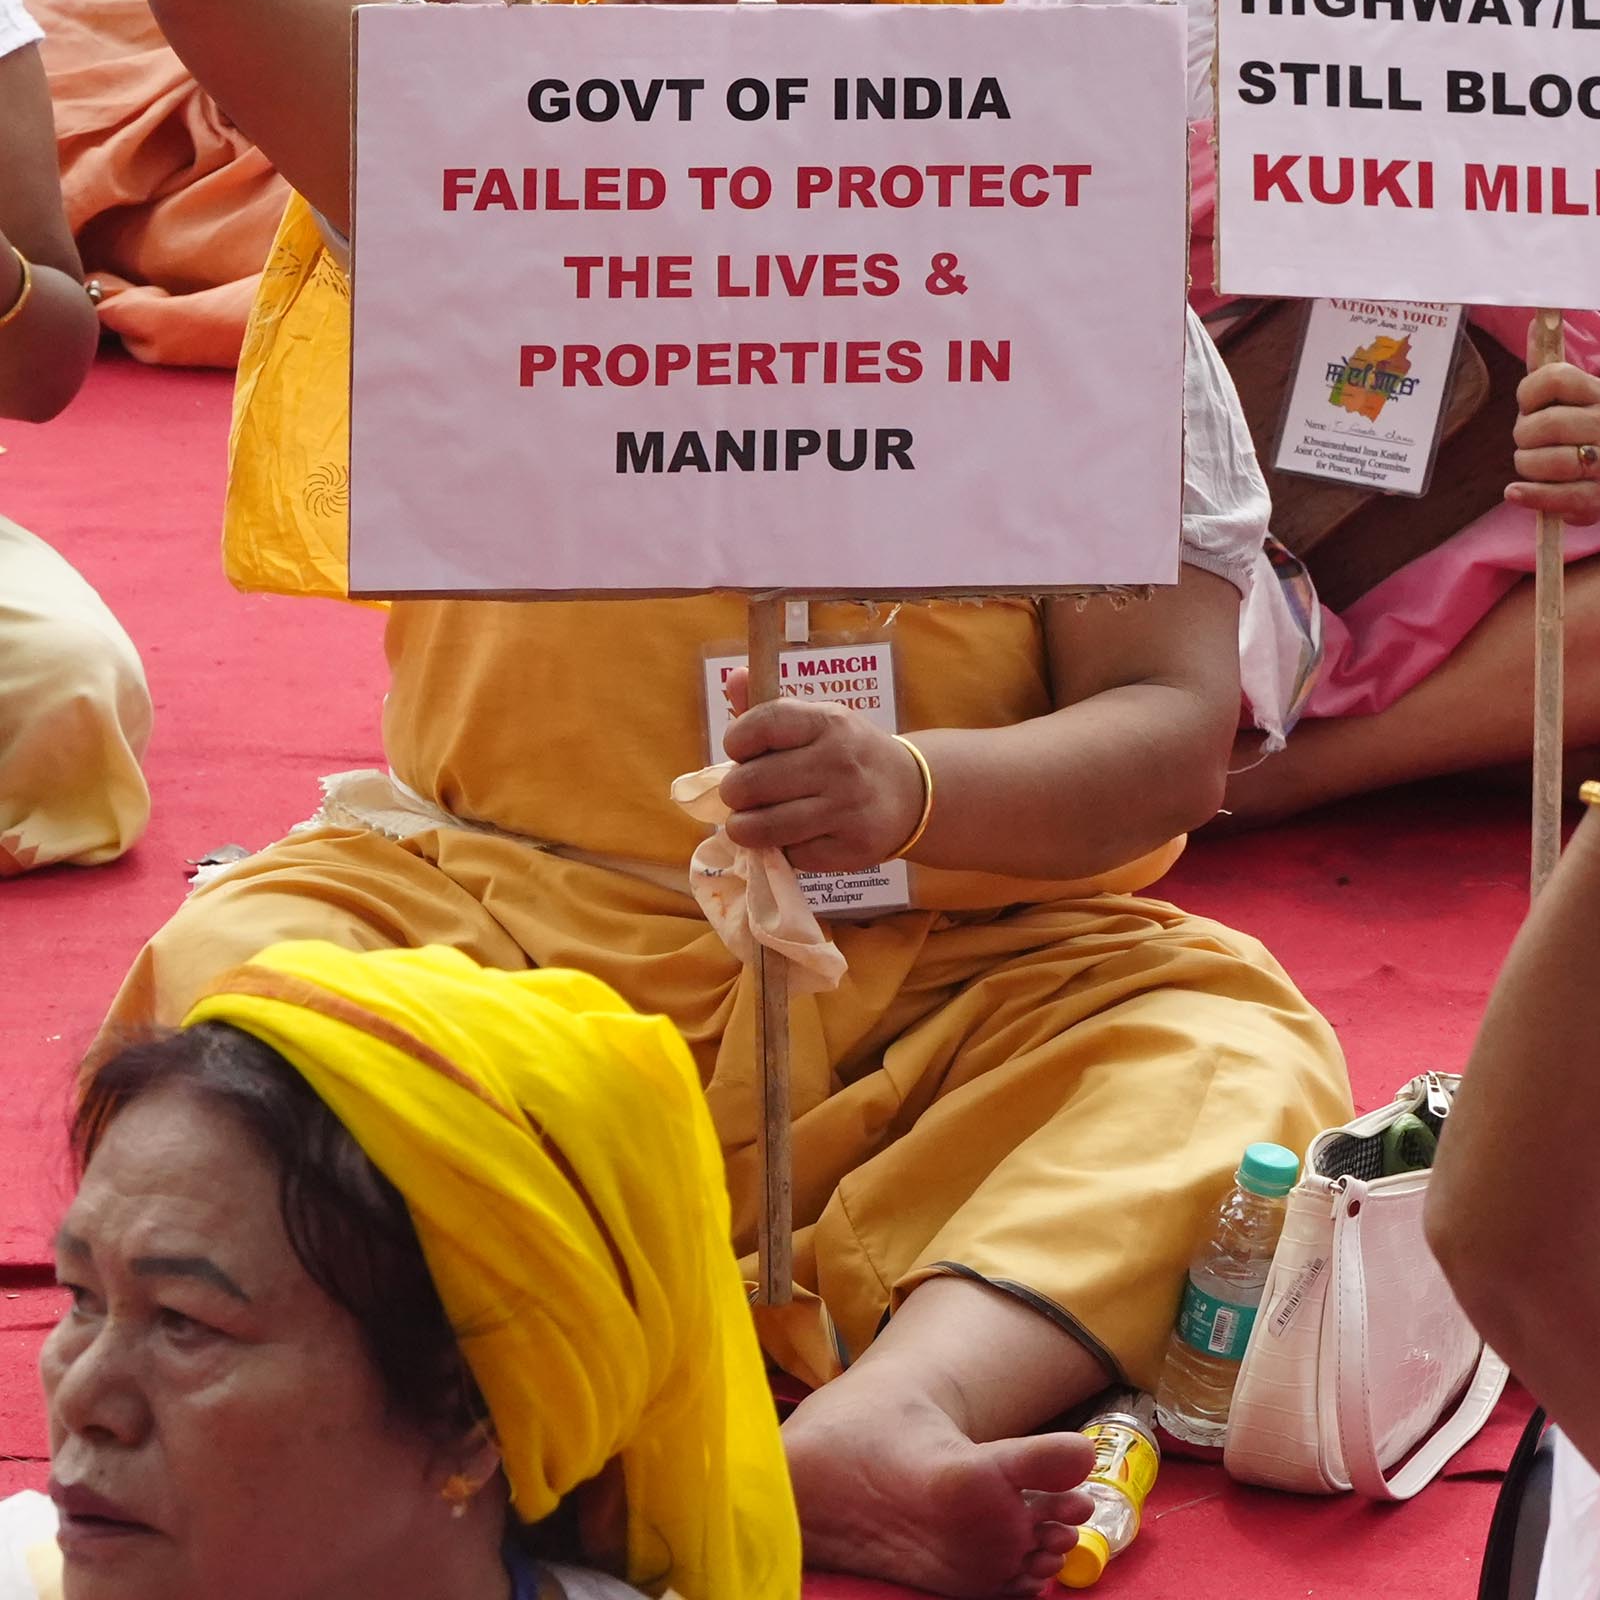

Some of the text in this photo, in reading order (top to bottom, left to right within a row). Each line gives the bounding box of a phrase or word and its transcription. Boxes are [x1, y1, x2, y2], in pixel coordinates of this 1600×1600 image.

[527, 77, 1011, 122] GOVT OF INDIA
[1238, 60, 1422, 112] STILL
[442, 164, 1092, 211] FAILED TO PROTECT
[1252, 153, 1434, 208] KUKI
[563, 252, 968, 299] THE LIVES &
[1403, 310, 1448, 328] VOICE
[519, 340, 1011, 387] PROPERTIES IN
[616, 428, 915, 473] MANIPUR
[798, 656, 877, 678] MARCH
[819, 677, 879, 695] VOICE
[827, 696, 881, 711] OICE
[821, 892, 864, 904] Manipur
[835, 877, 890, 890] Committee
